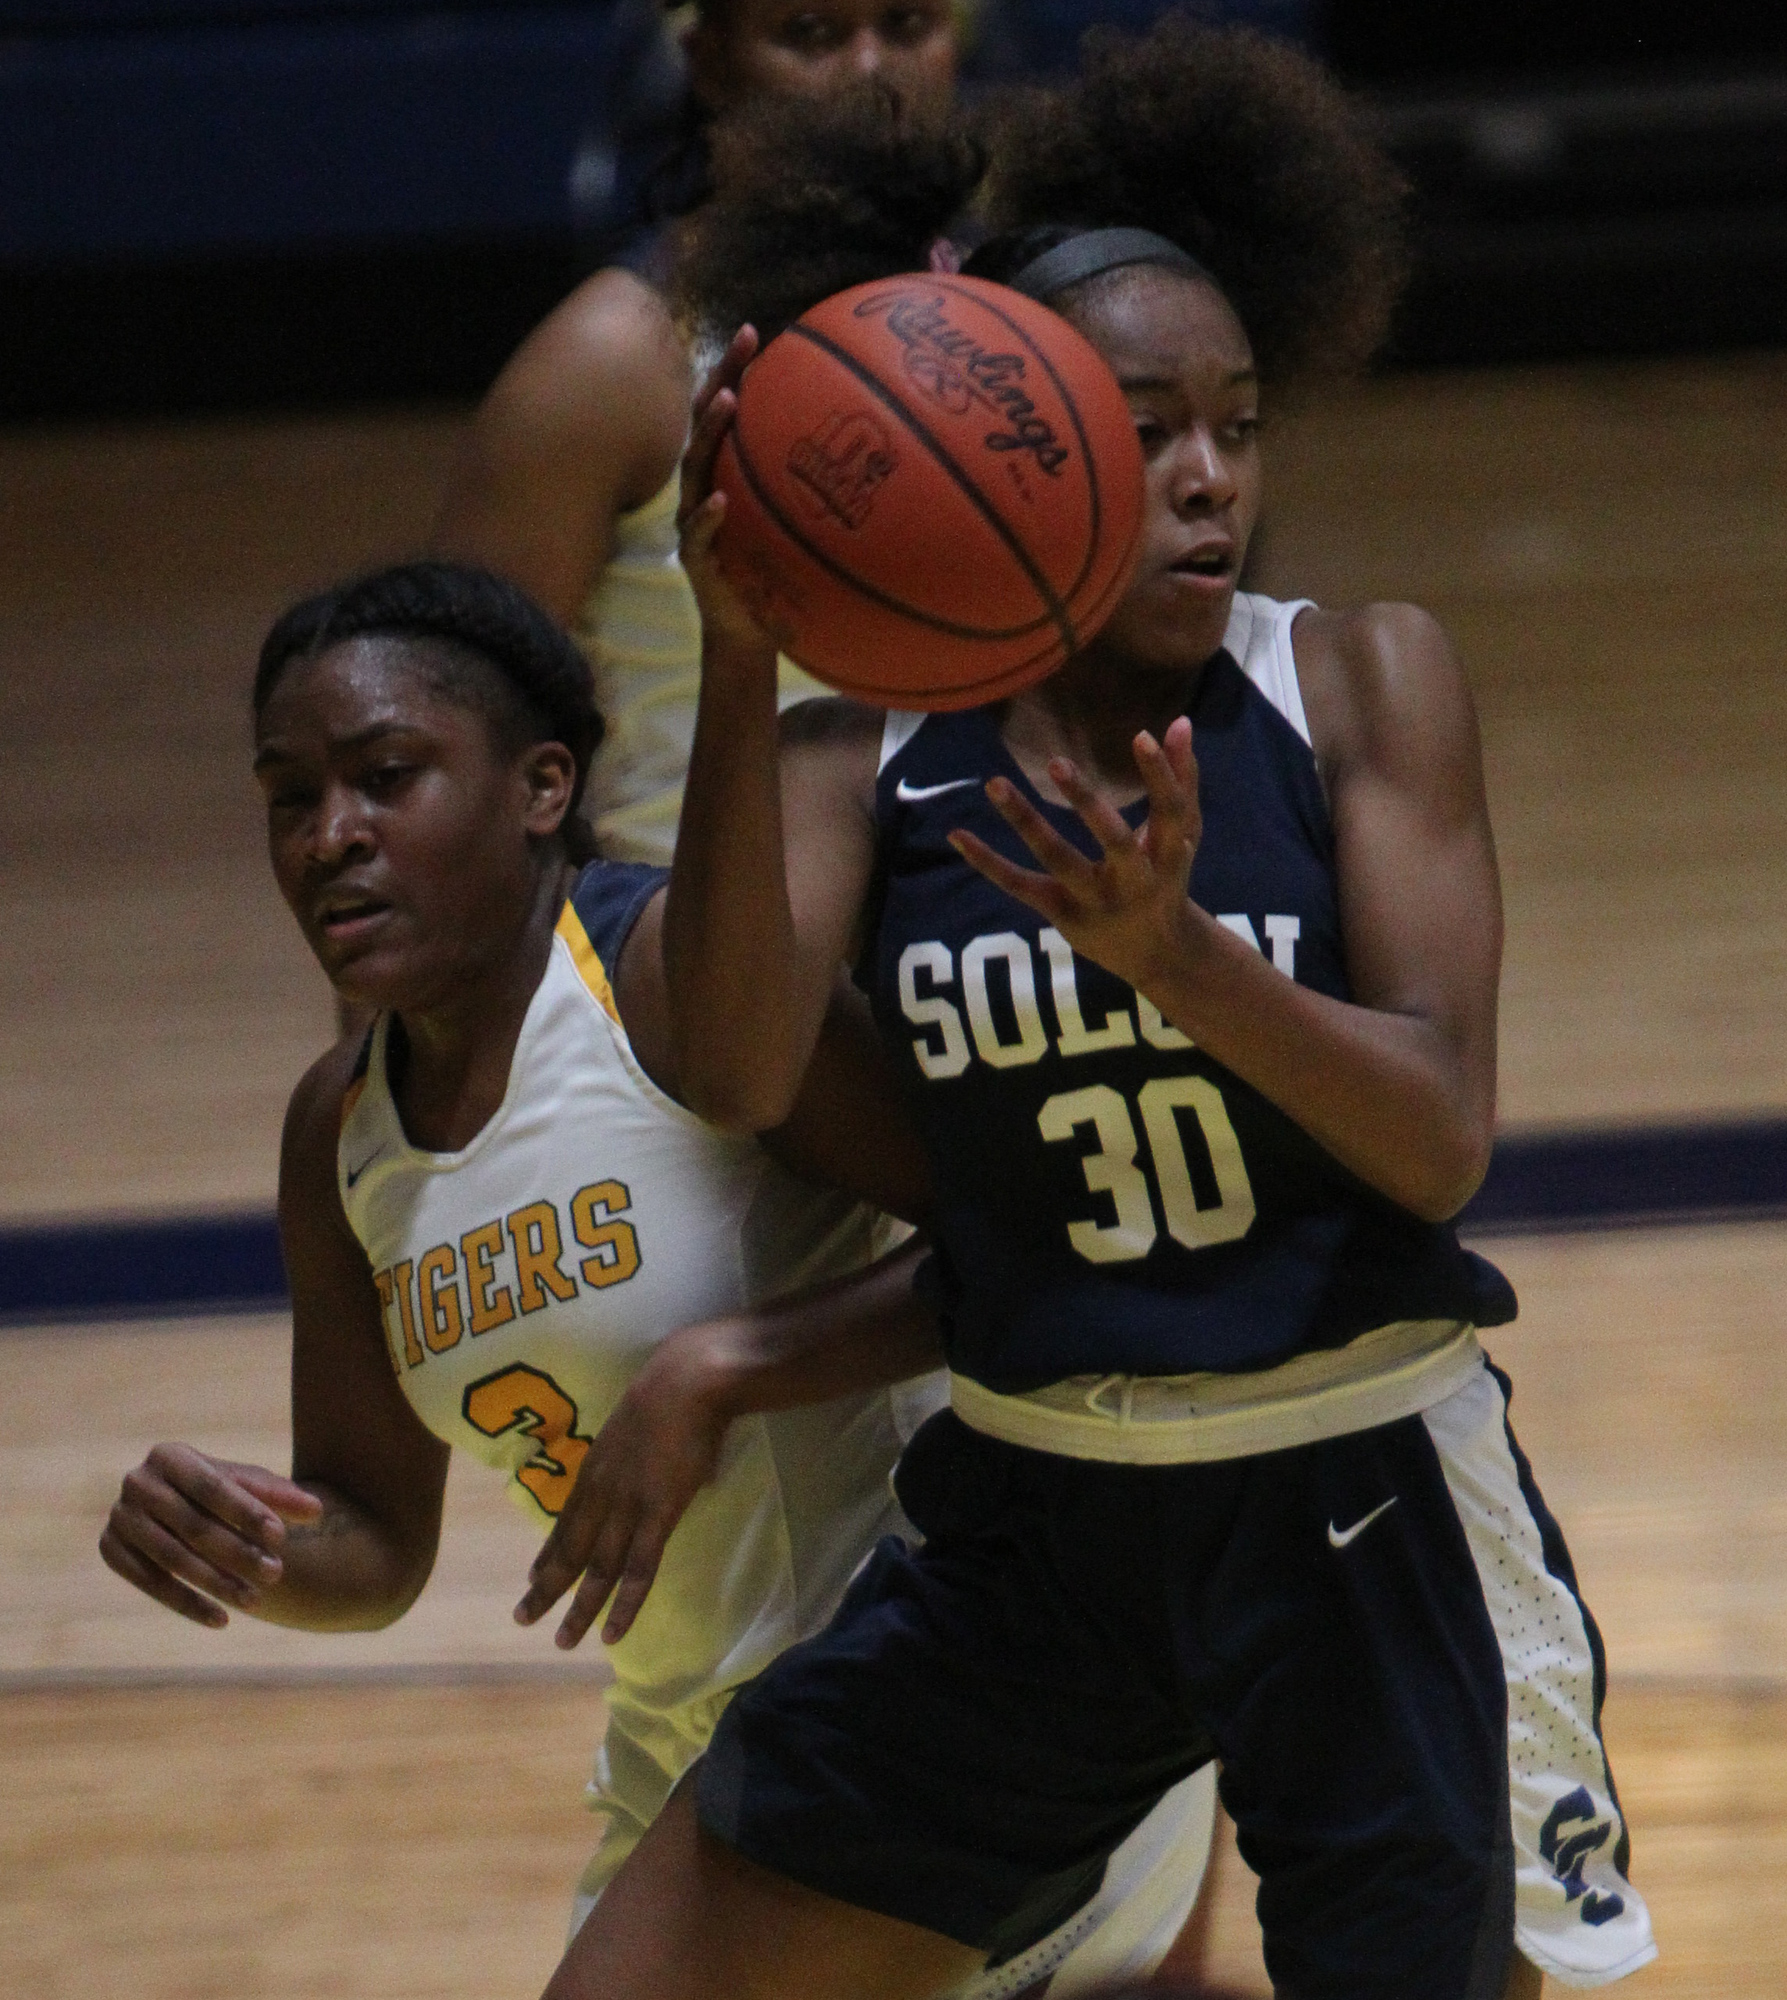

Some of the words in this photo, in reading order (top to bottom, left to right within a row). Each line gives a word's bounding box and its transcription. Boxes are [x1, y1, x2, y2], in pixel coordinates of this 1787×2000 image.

[854, 288, 1068, 476] Rawlings
[1036, 1075, 1257, 1264] 30
[461, 1360, 594, 1518] 3
